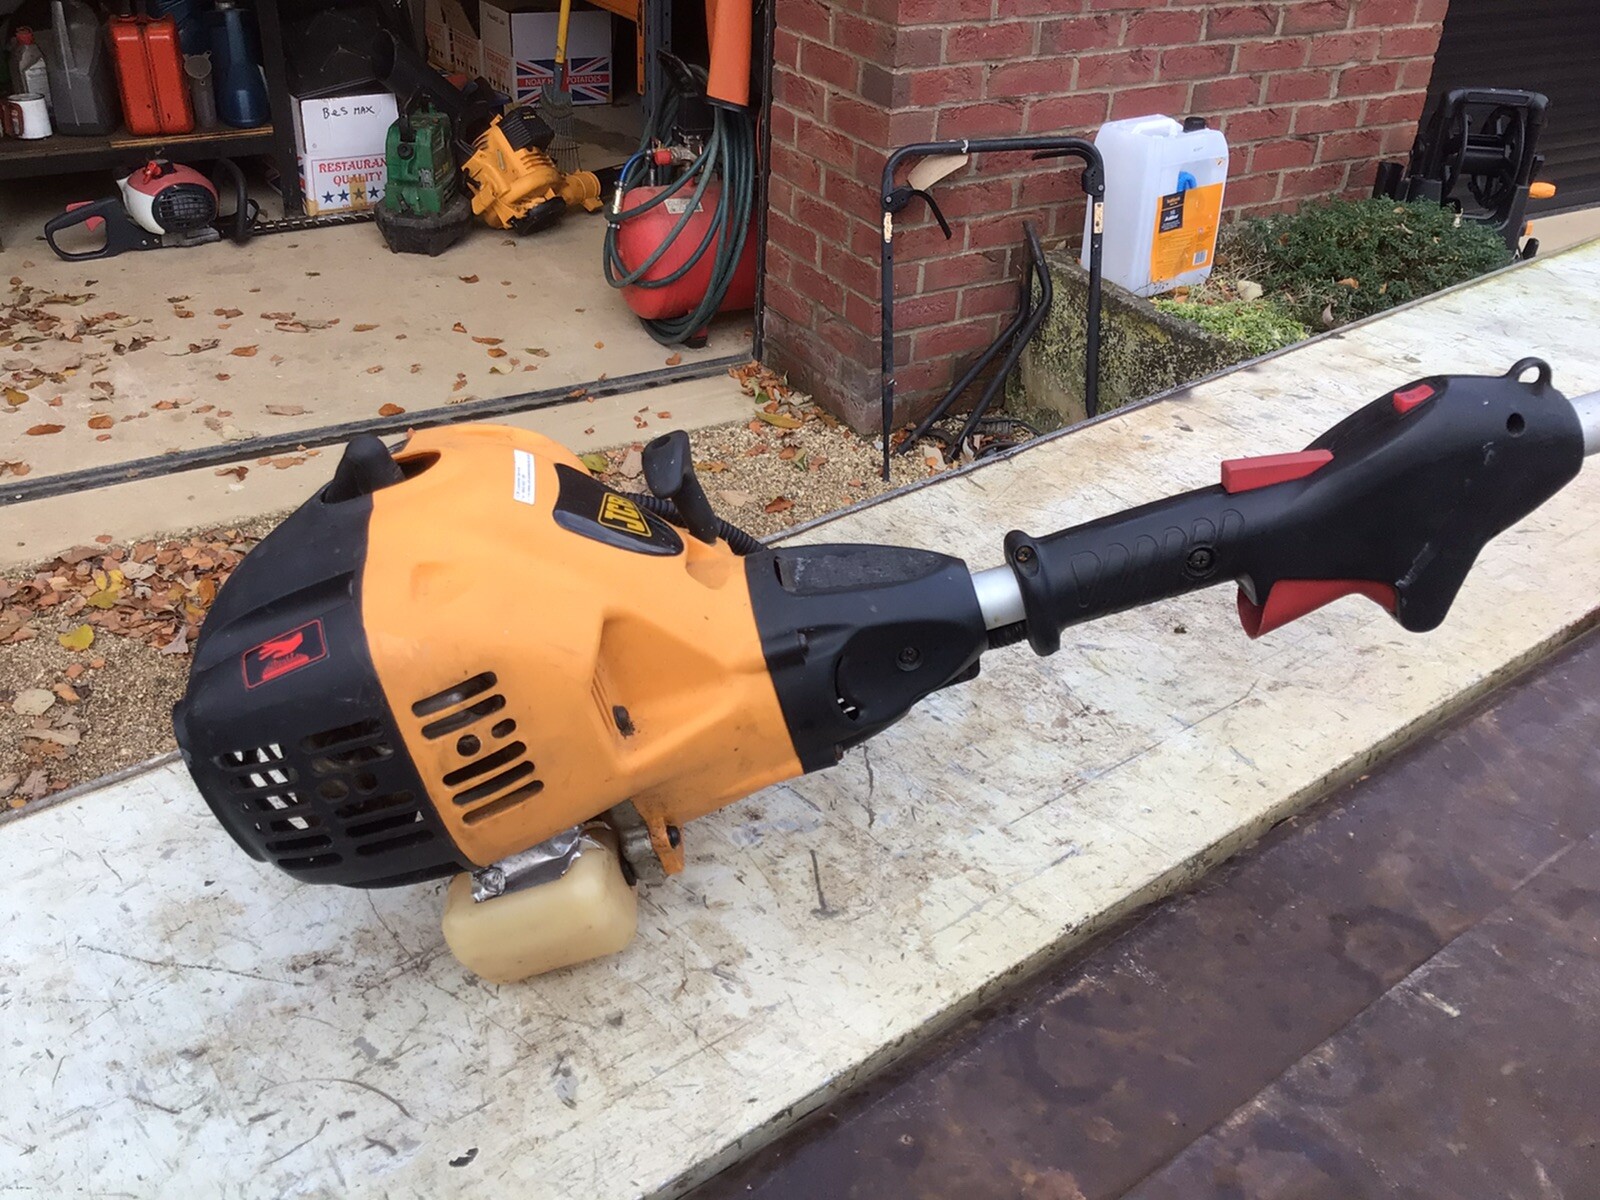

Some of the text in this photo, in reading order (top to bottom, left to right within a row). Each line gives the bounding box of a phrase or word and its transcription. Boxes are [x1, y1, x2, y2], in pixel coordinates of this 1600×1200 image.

[566, 75, 602, 84] POTATOES
[354, 106, 375, 115] MAX
[318, 158, 388, 173] RESTAURAN
[333, 172, 382, 187] QUALITY
[604, 496, 646, 533] JCB
